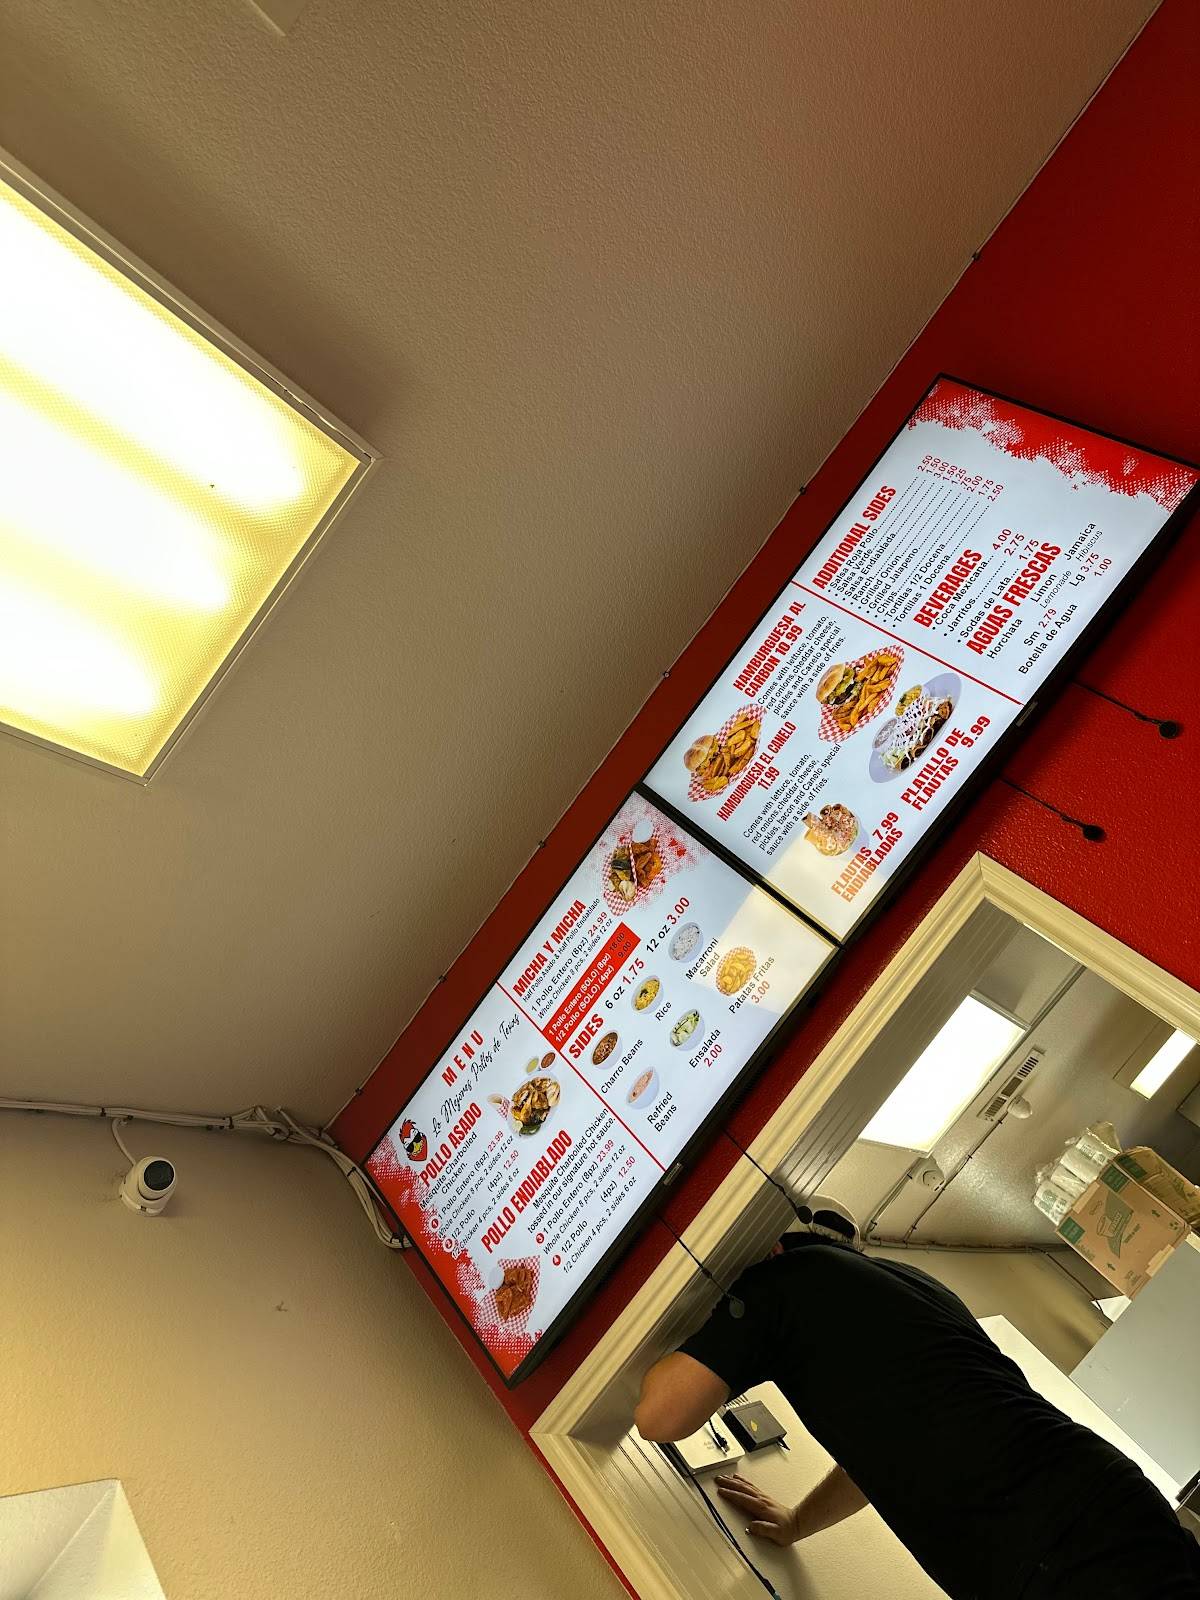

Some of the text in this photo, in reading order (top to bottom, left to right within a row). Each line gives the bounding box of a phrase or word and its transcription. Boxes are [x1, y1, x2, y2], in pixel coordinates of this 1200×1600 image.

[942, 465, 958, 481] 1.50
[966, 475, 983, 493] 2.00
[812, 485, 897, 590] ADDITIONAL SIDES
[829, 567, 849, 589] Salsa
[845, 549, 864, 567] Roja
[917, 455, 933, 472] 2.50
[836, 571, 857, 593] Salsa
[925, 457, 942, 474] 1.50
[844, 575, 864, 597] Salsa
[933, 461, 950, 479] 3.00
[860, 578, 883, 605] Grilled
[950, 468, 967, 485] 1.25
[868, 582, 892, 610] Grilled
[959, 476, 972, 490] .75
[884, 587, 913, 618] Tortillas
[909, 573, 923, 585] 1/2
[978, 479, 994, 496] 1.75
[893, 592, 922, 623] Tortillas
[987, 484, 1004, 502] 2.50
[1003, 533, 1025, 557] 2.75
[912, 549, 983, 628] BEVERAGES
[934, 603, 957, 626] Coca
[992, 528, 1012, 551] 4.00
[959, 610, 986, 638] Sodas
[983, 597, 995, 609] de
[1018, 539, 1040, 560] 1.75
[965, 542, 1062, 656] AGUAS FRESCAS
[986, 523, 1097, 659] Horchata Limon Jamaica
[1023, 552, 1100, 647] Sm 2.79 Lg 3.75
[1039, 530, 1103, 609] Lemonade Hibiscus
[732, 601, 807, 691] HAMBURGUESA AL
[744, 624, 803, 698] CARBON 10.99
[757, 616, 830, 705] Comes with lettuce, tomato,
[1018, 558, 1113, 675] Botella de Agua 1.00
[765, 696, 777, 710] red
[813, 620, 837, 646] cheese,
[772, 625, 841, 716] pickles and Canelo special
[780, 698, 798, 720] sauce
[796, 683, 810, 699] with
[811, 662, 826, 678] side
[823, 651, 832, 662] of
[828, 637, 846, 654] fries.
[716, 721, 797, 822] HAMBURGUESA EL CANELO
[757, 766, 780, 791] 11.99
[900, 727, 966, 804] PLATILLO DE
[911, 715, 991, 811] FLAUTAS 9.99
[830, 811, 899, 897] FLAUTAS 7.99
[840, 825, 905, 904] ENDIABLADAS
[512, 899, 587, 998] MICHA Y MICHA
[535, 985, 553, 1007] Pollo
[550, 958, 573, 985] Entero
[571, 936, 589, 959] (8pz)
[587, 911, 608, 938] 24.99
[551, 1013, 567, 1032] Pollo
[563, 992, 582, 1015] Entero
[579, 968, 600, 994] (SOLO)
[596, 952, 612, 971] (8pz)
[568, 897, 690, 1059] SIDES 6 oz 1.75 12 oz 3.00
[699, 951, 721, 977] Salad
[728, 956, 775, 1014] Patatas Fritas
[751, 980, 771, 1004] 3.00
[493, 1037, 501, 1053] de
[555, 964, 615, 1042] 1/2 Pollo (SOLO) (4pz)
[655, 1002, 672, 1022] Rice
[600, 1039, 643, 1094] Charro Beans
[688, 1029, 721, 1069] Ensalada
[703, 1043, 723, 1068] 2.00
[417, 1102, 482, 1189] POLLO ASADO
[646, 1091, 673, 1125] Refried
[653, 1104, 677, 1133] Beans
[419, 1131, 478, 1210] Mesquite Charboiled
[441, 1162, 468, 1195] Chicken.
[480, 1129, 573, 1254] POLLO ENDIABLADO
[527, 1117, 616, 1234] tossed in our signature hot sauce.
[532, 1108, 609, 1210] Mesquite Charboiled Chicken
[543, 1139, 614, 1235] 1 Pollo Entero (8pz) 23.99
